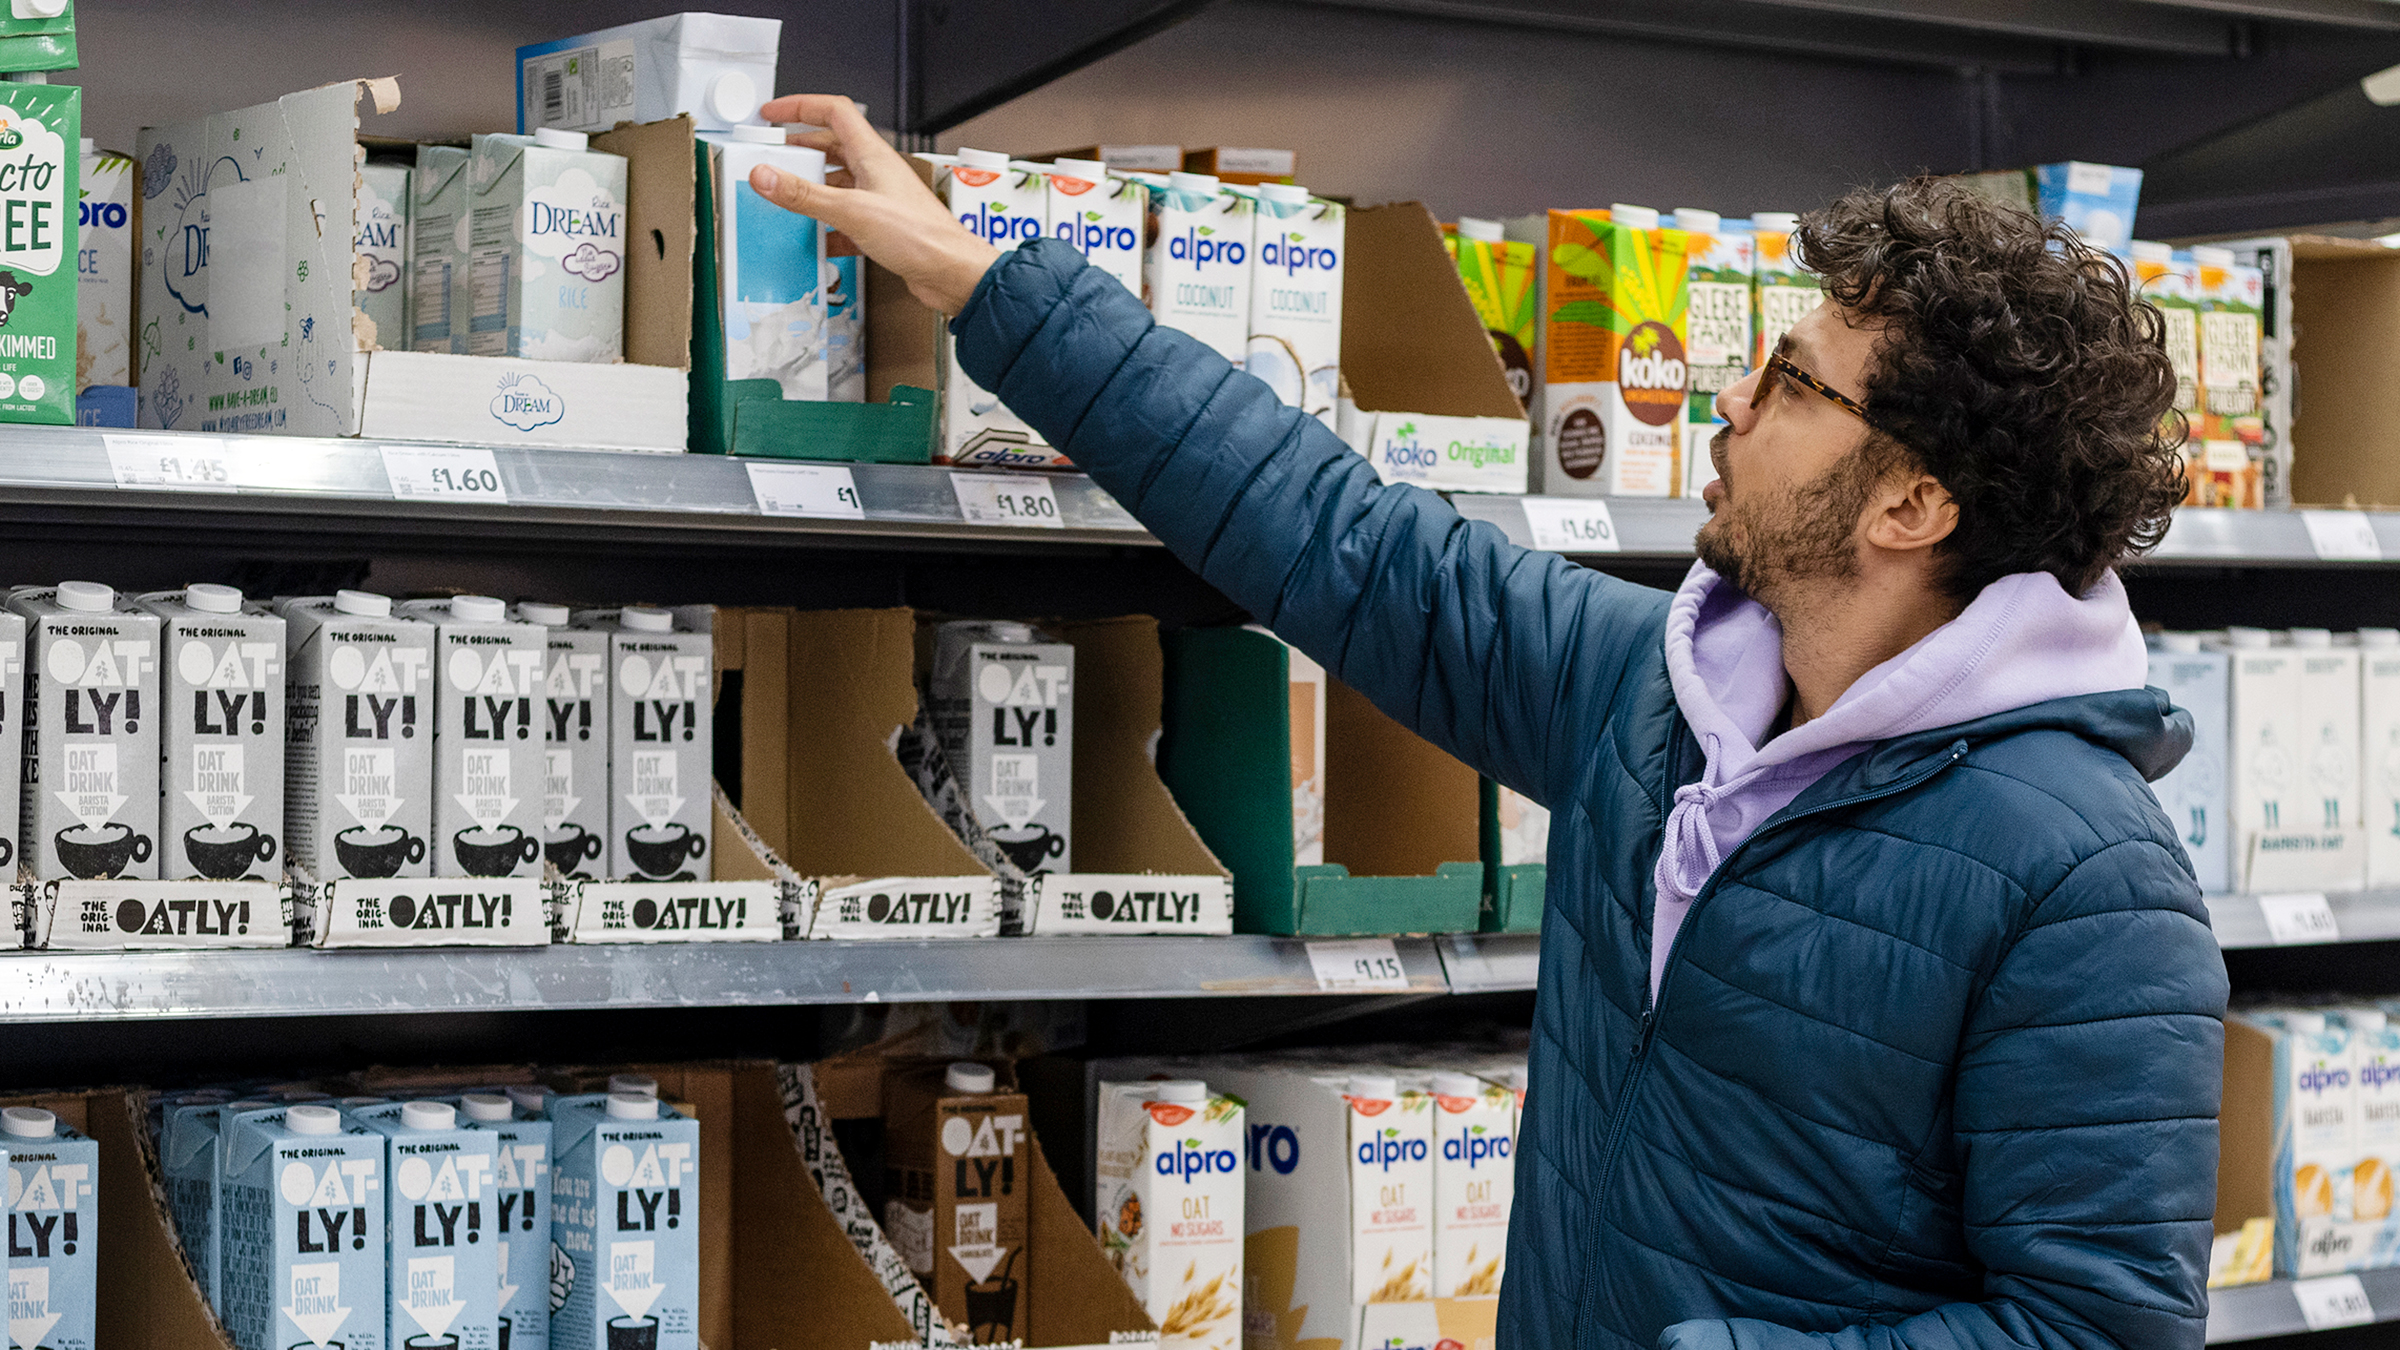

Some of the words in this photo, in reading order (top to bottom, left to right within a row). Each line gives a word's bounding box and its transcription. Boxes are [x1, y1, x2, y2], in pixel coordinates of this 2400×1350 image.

[0, 133, 17, 145] rla
[0, 154, 57, 192] cto
[5, 199, 52, 252] EE
[530, 201, 617, 240] DREAM
[960, 202, 1040, 245] alpro
[1057, 211, 1135, 257] alpro
[1170, 226, 1245, 271] alpro
[1263, 233, 1336, 277] alpro
[78, 249, 98, 273] CE
[559, 285, 588, 310] RICE
[1177, 283, 1235, 308] COCONUT
[1271, 288, 1328, 314] COCONUT
[0, 334, 56, 360] KIMMED
[2, 363, 17, 372] LIFE
[1620, 348, 1687, 390] koko
[504, 394, 551, 415] DREAM
[975, 448, 1046, 465] alpro
[1384, 439, 1438, 468] koko
[1448, 440, 1516, 469] Original
[160, 456, 229, 482] £1.45
[431, 467, 498, 492] £1.60
[838, 487, 858, 508] £1
[998, 494, 1054, 517] £1.80
[1562, 518, 1610, 540] £1.60
[47, 625, 69, 636] THE
[71, 626, 120, 636] ORIGINAL
[178, 628, 199, 637] THE
[201, 628, 246, 637] ORIGINAL
[330, 632, 350, 642] THE
[352, 633, 397, 642] ORIGINAL
[449, 635, 468, 645] THE
[470, 635, 512, 645] ORIGINAL
[619, 643, 637, 651] THE
[47, 638, 154, 686] OAT-
[178, 640, 280, 688] OAT-
[330, 645, 430, 693] OAT-
[449, 647, 544, 695] OAT-
[546, 652, 604, 697] AT-
[619, 654, 707, 699] OAT-
[978, 663, 1070, 706] OAT-
[65, 688, 140, 735] LY!
[194, 689, 266, 736] LY!
[345, 693, 416, 740] LY!
[464, 695, 530, 741] LY!
[546, 698, 591, 742] Y!
[634, 700, 695, 742] LY!
[994, 707, 1057, 747] LY!
[69, 750, 98, 771] OAT
[198, 751, 225, 771] OAT
[349, 754, 376, 774] OAT
[467, 755, 493, 775] OAT
[637, 757, 661, 776] OAT
[69, 772, 113, 793] DRINK
[198, 772, 240, 792] DRINK
[349, 775, 391, 796] DRINK
[467, 775, 506, 796] DRINK
[637, 777, 674, 796] DRINK
[79, 795, 109, 806] BARISTA
[206, 794, 236, 805] BARISTA
[81, 901, 107, 911] THE
[356, 898, 380, 908] THE
[356, 909, 386, 919] ORIG-
[388, 894, 513, 929] OATLY!
[603, 901, 624, 910] THE
[632, 897, 747, 929] OATLY!
[867, 893, 971, 924] OATLY!
[1091, 891, 1199, 923] OATLY!
[80, 912, 113, 922] ORIG-
[82, 923, 111, 933] INAL
[116, 899, 250, 935] OATLY!
[358, 920, 384, 929] INAL
[602, 912, 630, 920] ORIG-
[603, 921, 627, 929] INAL
[1355, 958, 1400, 980] £1.15
[2299, 1062, 2351, 1097] alpro
[2361, 1058, 2400, 1092] alpr
[602, 1132, 620, 1141] THE
[623, 1131, 663, 1141] ORIGINAL
[941, 1114, 1025, 1158] OAT-
[1444, 1127, 1511, 1169] alpro
[10, 1153, 58, 1163] ORIGINAL
[280, 1150, 299, 1159] THE
[302, 1148, 346, 1158] ORIGINAL
[398, 1145, 416, 1154] THE
[419, 1143, 461, 1153] ORIGINAL
[1358, 1130, 1427, 1172] alpro
[498, 1144, 548, 1188] AT-
[602, 1143, 694, 1188] OAT-
[1156, 1140, 1237, 1184] alpro
[280, 1159, 379, 1207] OAT-
[397, 1154, 493, 1201] OAT-
[574, 1178, 590, 1198] are
[956, 1157, 1014, 1197] LY!
[1380, 1183, 1405, 1208] OAT
[1466, 1180, 1491, 1203] OAT
[498, 1190, 536, 1233] Y!
[617, 1188, 680, 1232] LY!
[1182, 1196, 1210, 1219] OAT
[8, 1212, 78, 1258] LY!
[298, 1207, 366, 1254] LY!
[414, 1202, 481, 1248] LY!
[1171, 1223, 1184, 1238] NO
[1187, 1221, 1224, 1236] SUGARS
[566, 1231, 594, 1251] now.
[613, 1254, 637, 1273] OAT
[295, 1277, 321, 1296] OAT
[411, 1270, 436, 1288] OAT
[613, 1273, 651, 1291] DRINK
[8, 1300, 46, 1320] RINK
[295, 1295, 336, 1317] DRINK
[411, 1288, 451, 1309] DRINK
